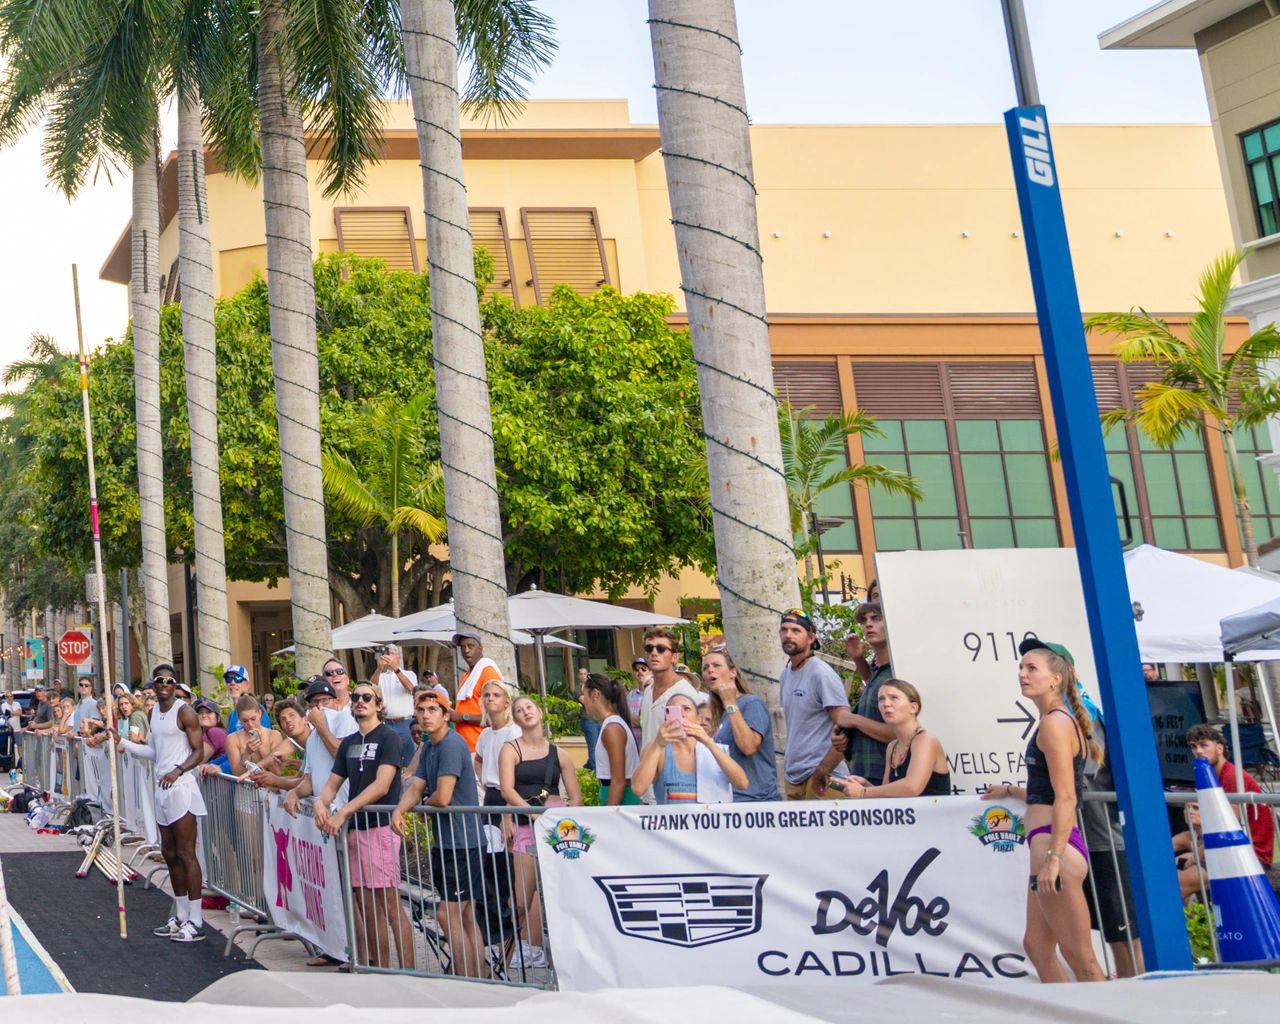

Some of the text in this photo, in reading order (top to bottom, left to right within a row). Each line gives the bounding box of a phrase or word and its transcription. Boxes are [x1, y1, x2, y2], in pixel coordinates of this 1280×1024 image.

[1019, 115, 1054, 187] GILL
[60, 641, 89, 655] STOP
[639, 807, 916, 830] THANK YOU TO OUR GREAT SPONSORS
[983, 832, 1022, 843] POLE VAULT
[811, 847, 950, 948] DeVoe
[757, 950, 1029, 979] CADILLAC
